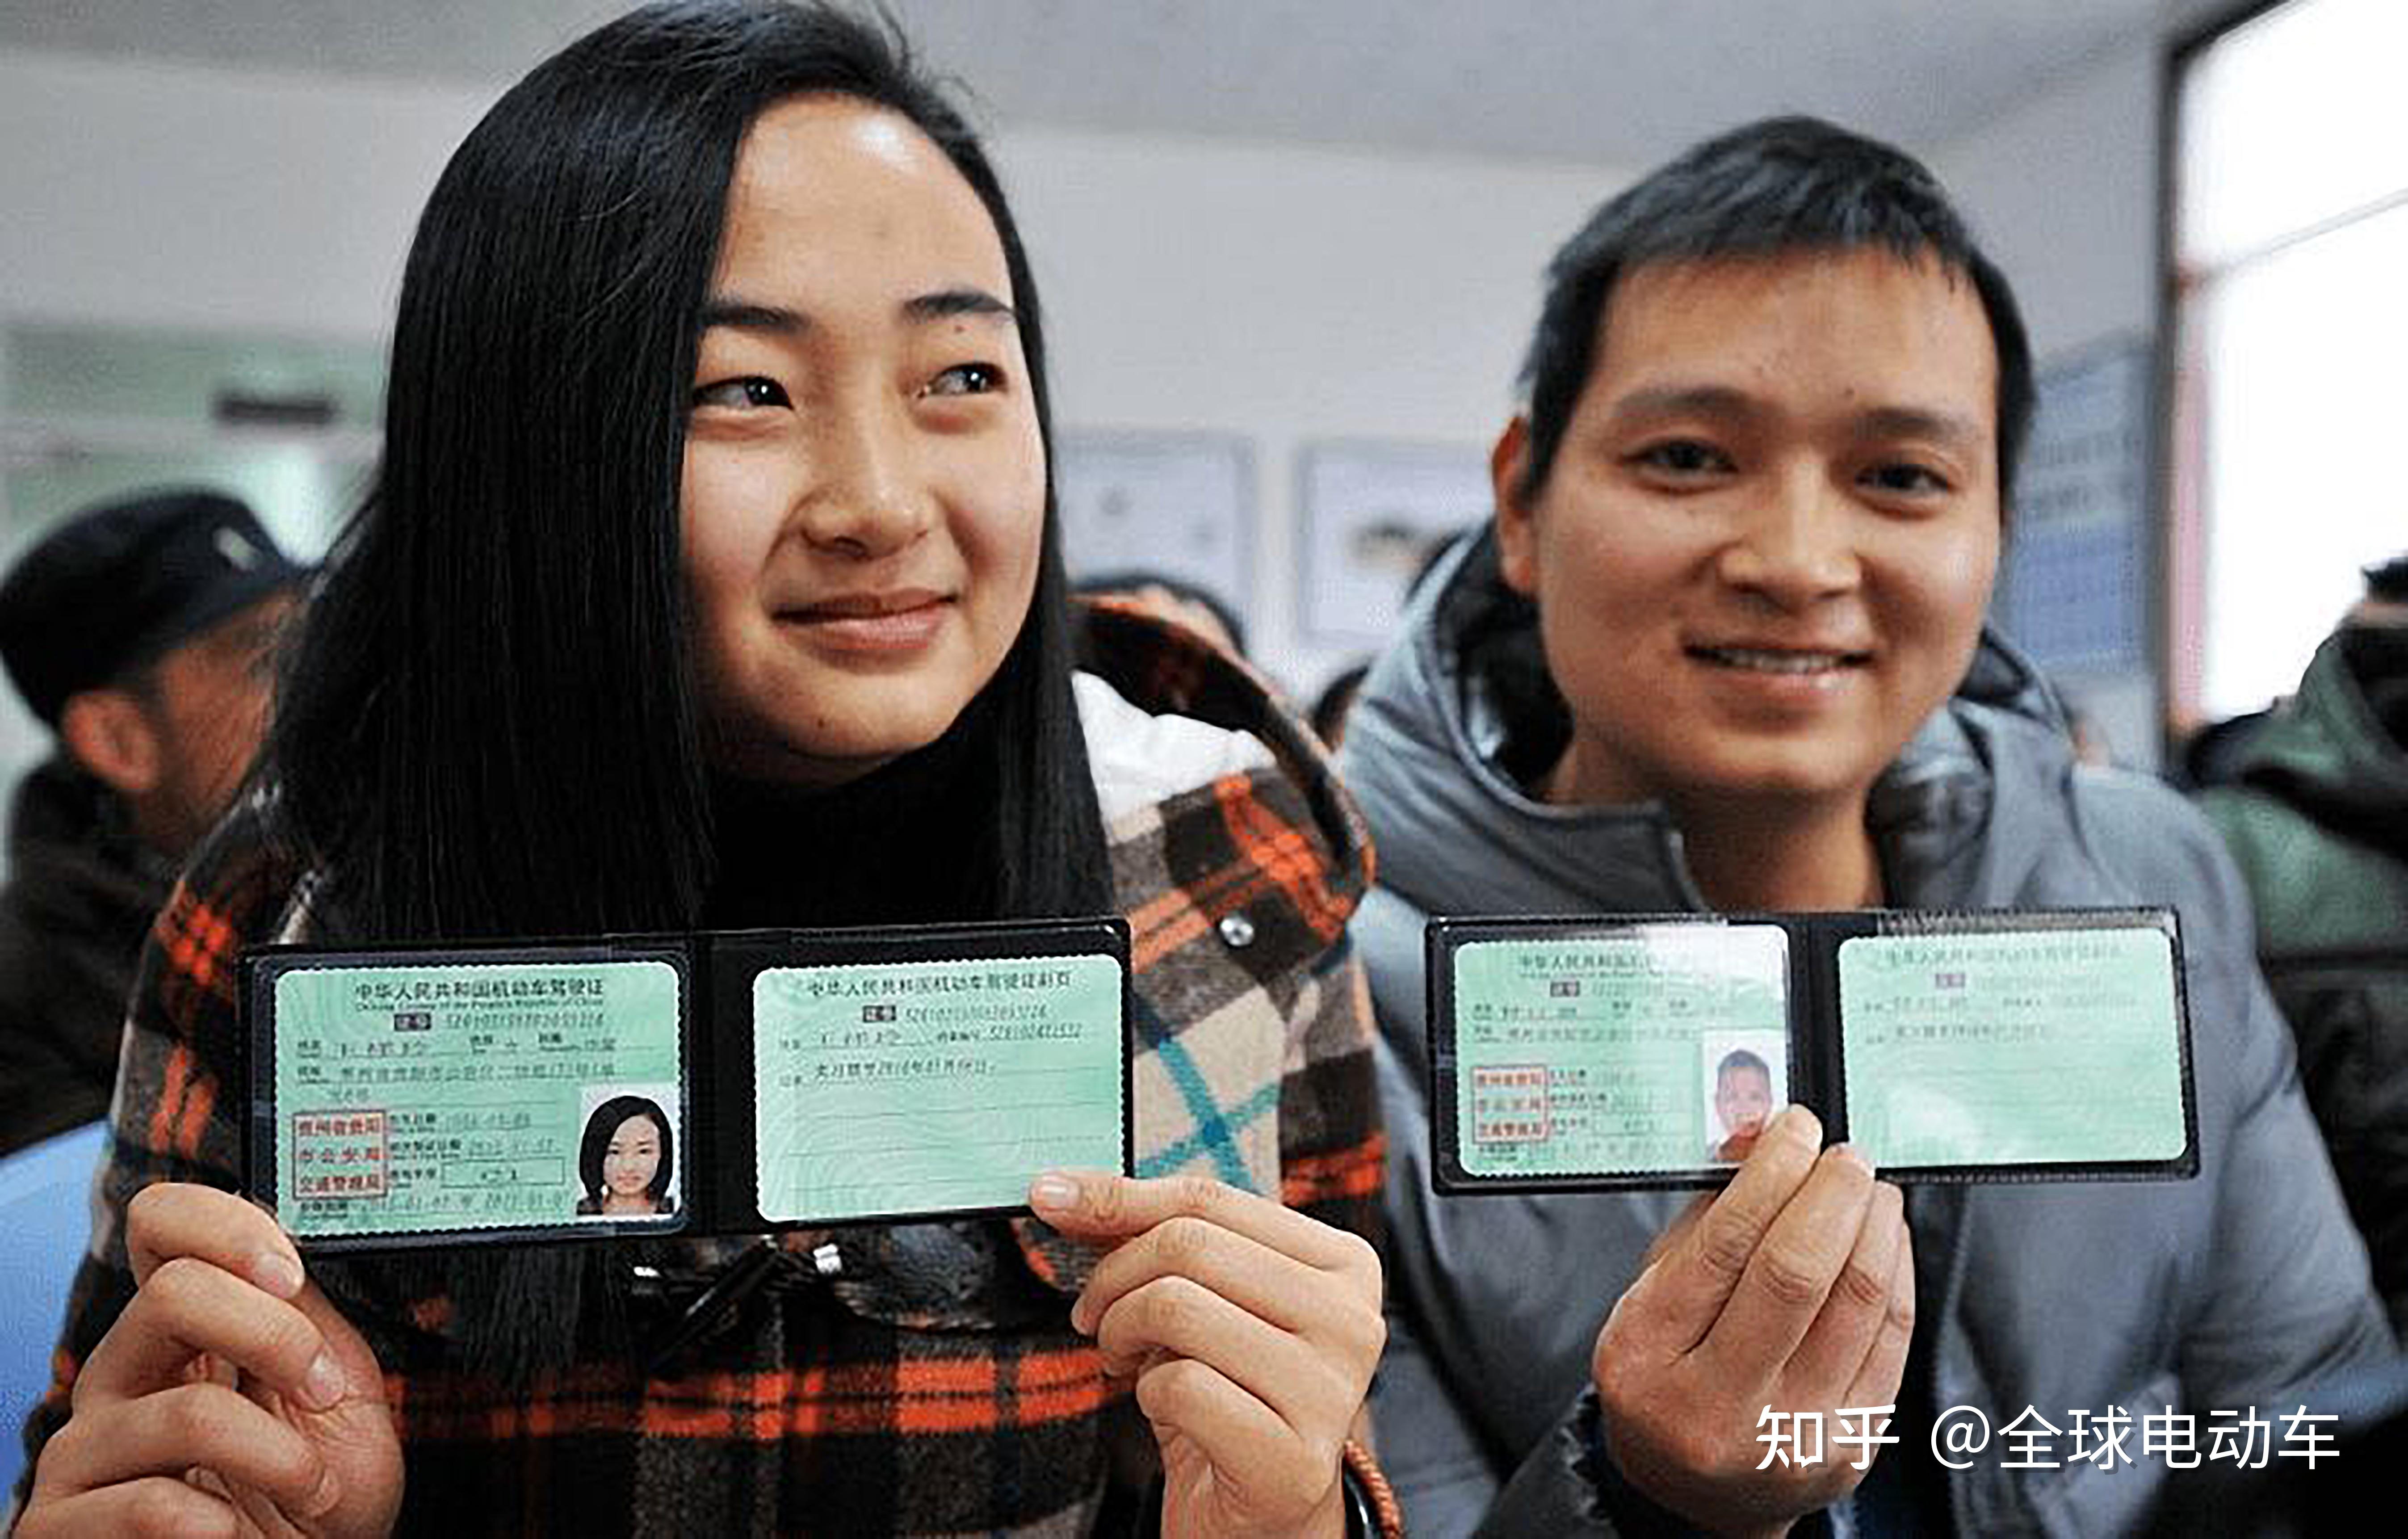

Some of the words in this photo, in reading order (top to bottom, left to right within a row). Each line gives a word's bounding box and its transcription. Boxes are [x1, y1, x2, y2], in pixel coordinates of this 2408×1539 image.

[356, 978, 603, 1001] 中华人民共和国机动车驾驶证
